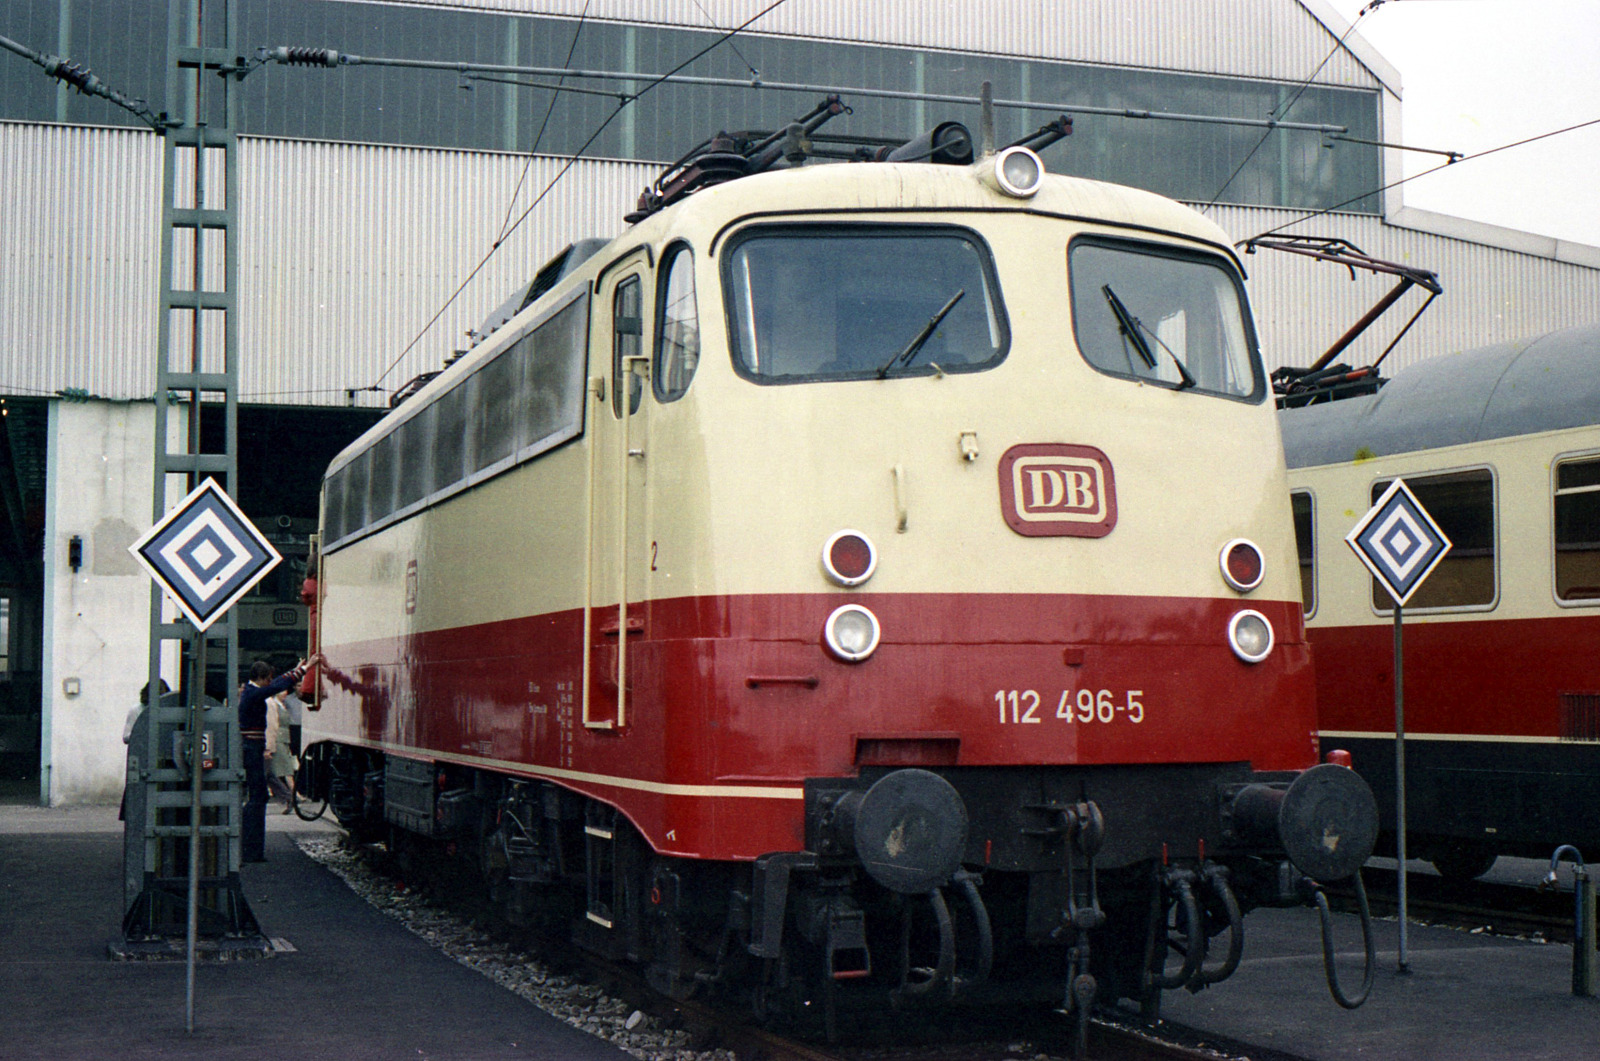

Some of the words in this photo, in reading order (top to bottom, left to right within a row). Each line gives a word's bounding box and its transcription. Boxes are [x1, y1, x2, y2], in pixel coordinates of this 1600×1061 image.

[1025, 468, 1095, 509] DB
[651, 541, 658, 571] 2
[994, 689, 1041, 724] 112
[1055, 689, 1145, 724] 496-5
